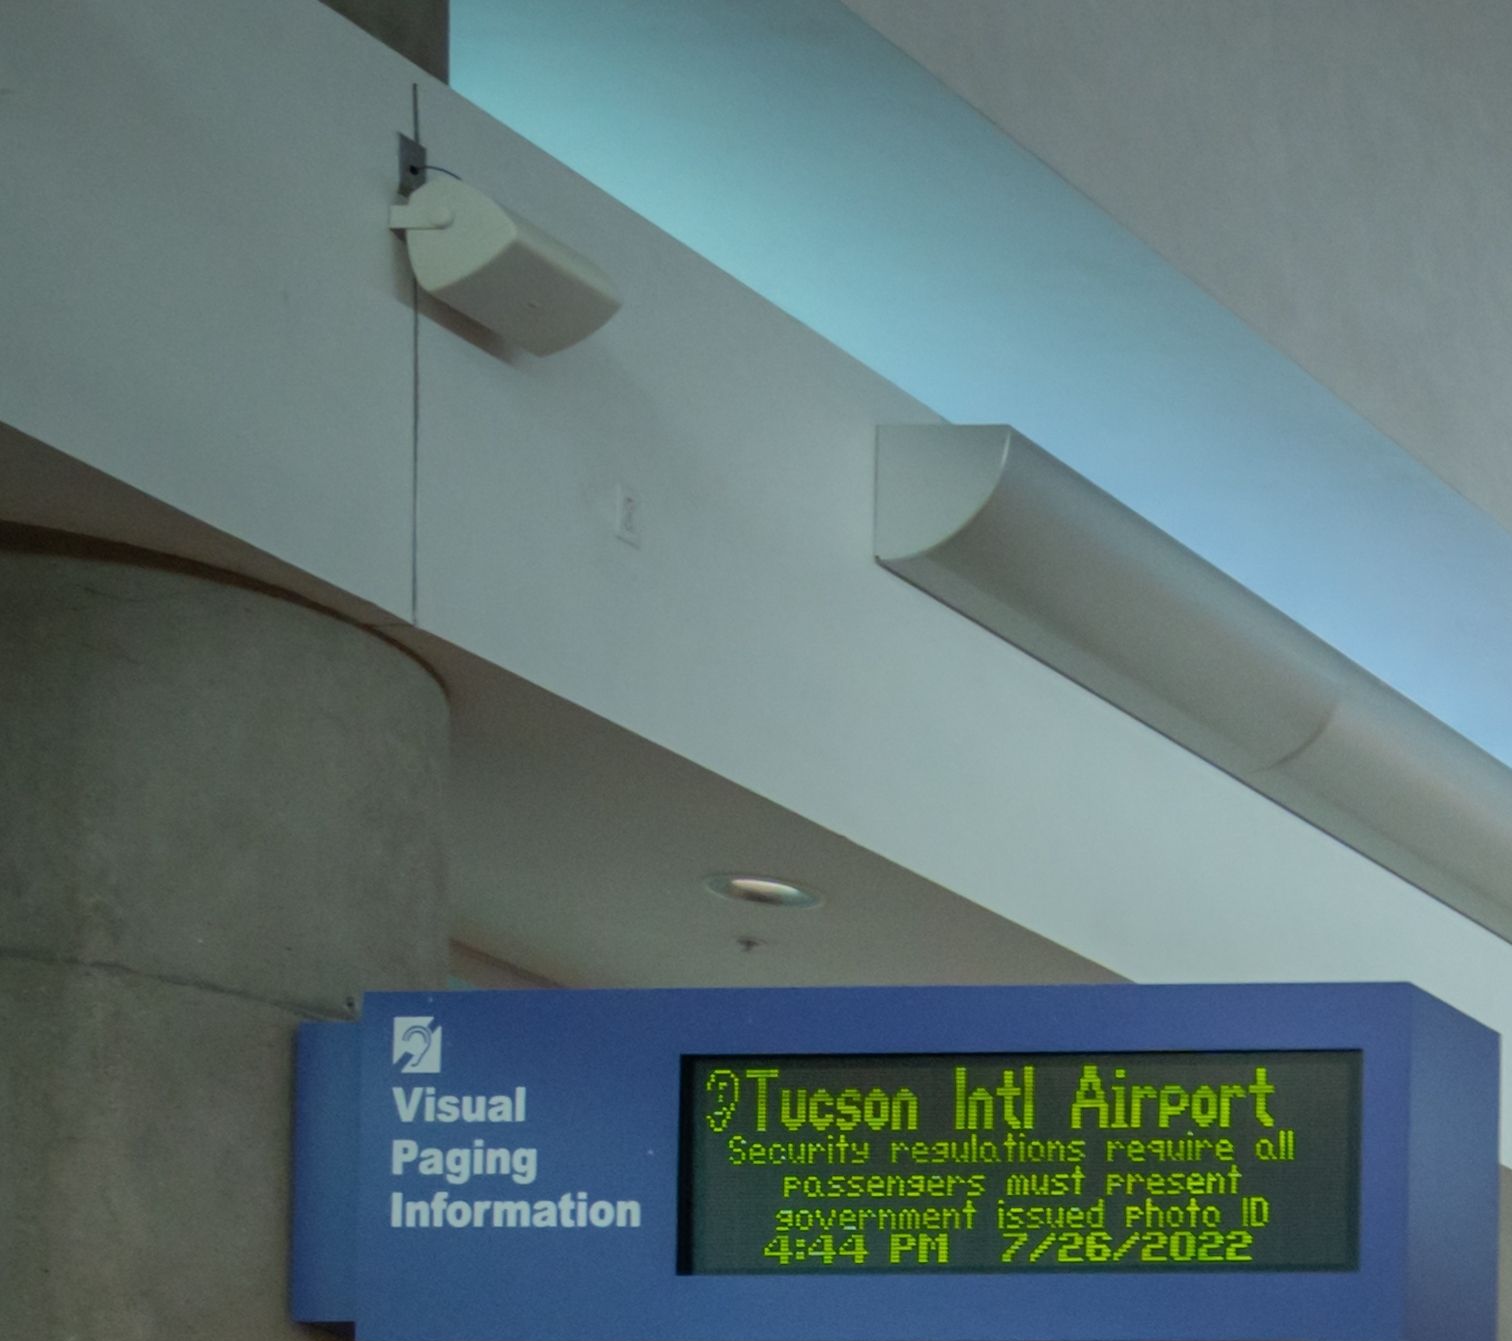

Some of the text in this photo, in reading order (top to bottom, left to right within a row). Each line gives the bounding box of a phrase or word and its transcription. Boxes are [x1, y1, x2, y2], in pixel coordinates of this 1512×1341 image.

[393, 1087, 525, 1123] Visual
[746, 1065, 1275, 1132] Tucson Intl Airport
[393, 1140, 537, 1184] Paging
[728, 1129, 1296, 1165] Security regulations require all
[783, 1164, 1242, 1198] passengers must present
[391, 1192, 640, 1228] Information
[775, 1197, 1270, 1231] government issued photo ID
[763, 1231, 1253, 1265] 4:44 PM 7/26/2022
